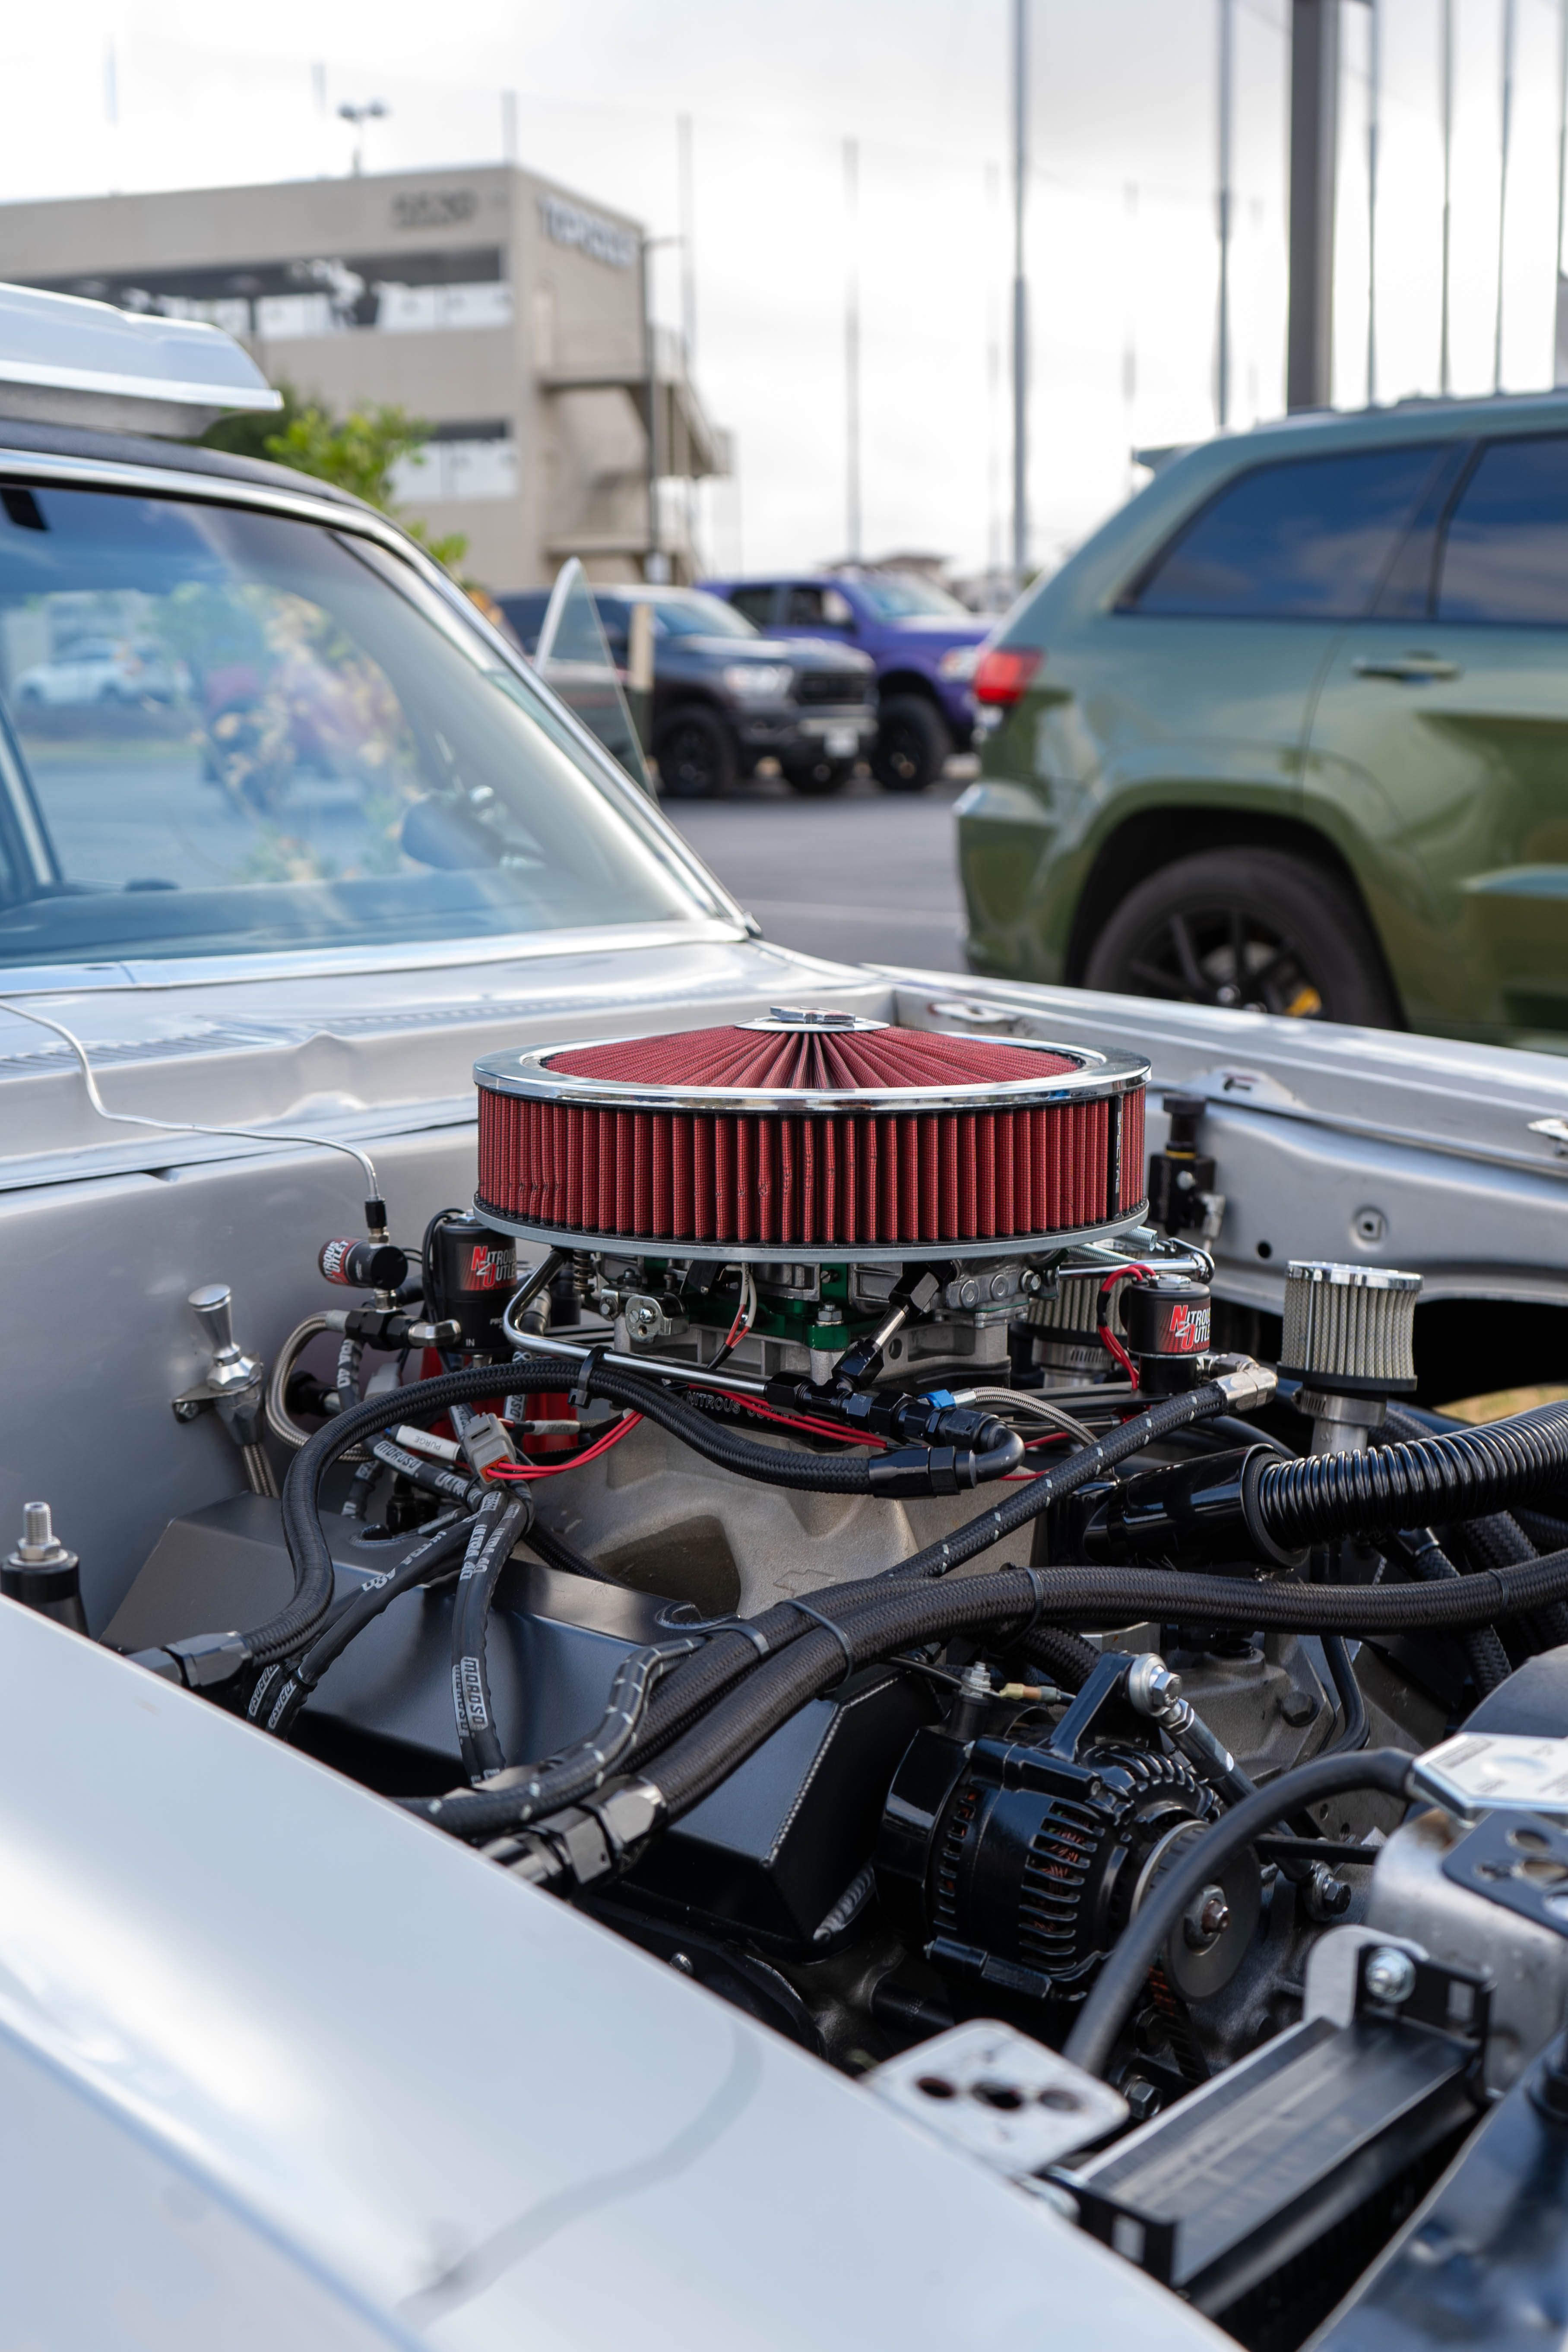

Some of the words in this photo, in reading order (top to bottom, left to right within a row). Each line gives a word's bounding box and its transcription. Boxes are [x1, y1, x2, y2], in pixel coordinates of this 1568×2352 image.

[466, 1338, 475, 1347] IN
[687, 1391, 740, 1414] NITROUS
[376, 1441, 422, 1469] MOROSO
[414, 1436, 442, 1451] PURGE
[464, 1524, 488, 1561] ULTRA
[459, 1561, 475, 1581] 40
[271, 1681, 295, 1726] OROSO
[463, 1658, 485, 1724] MOROSO
